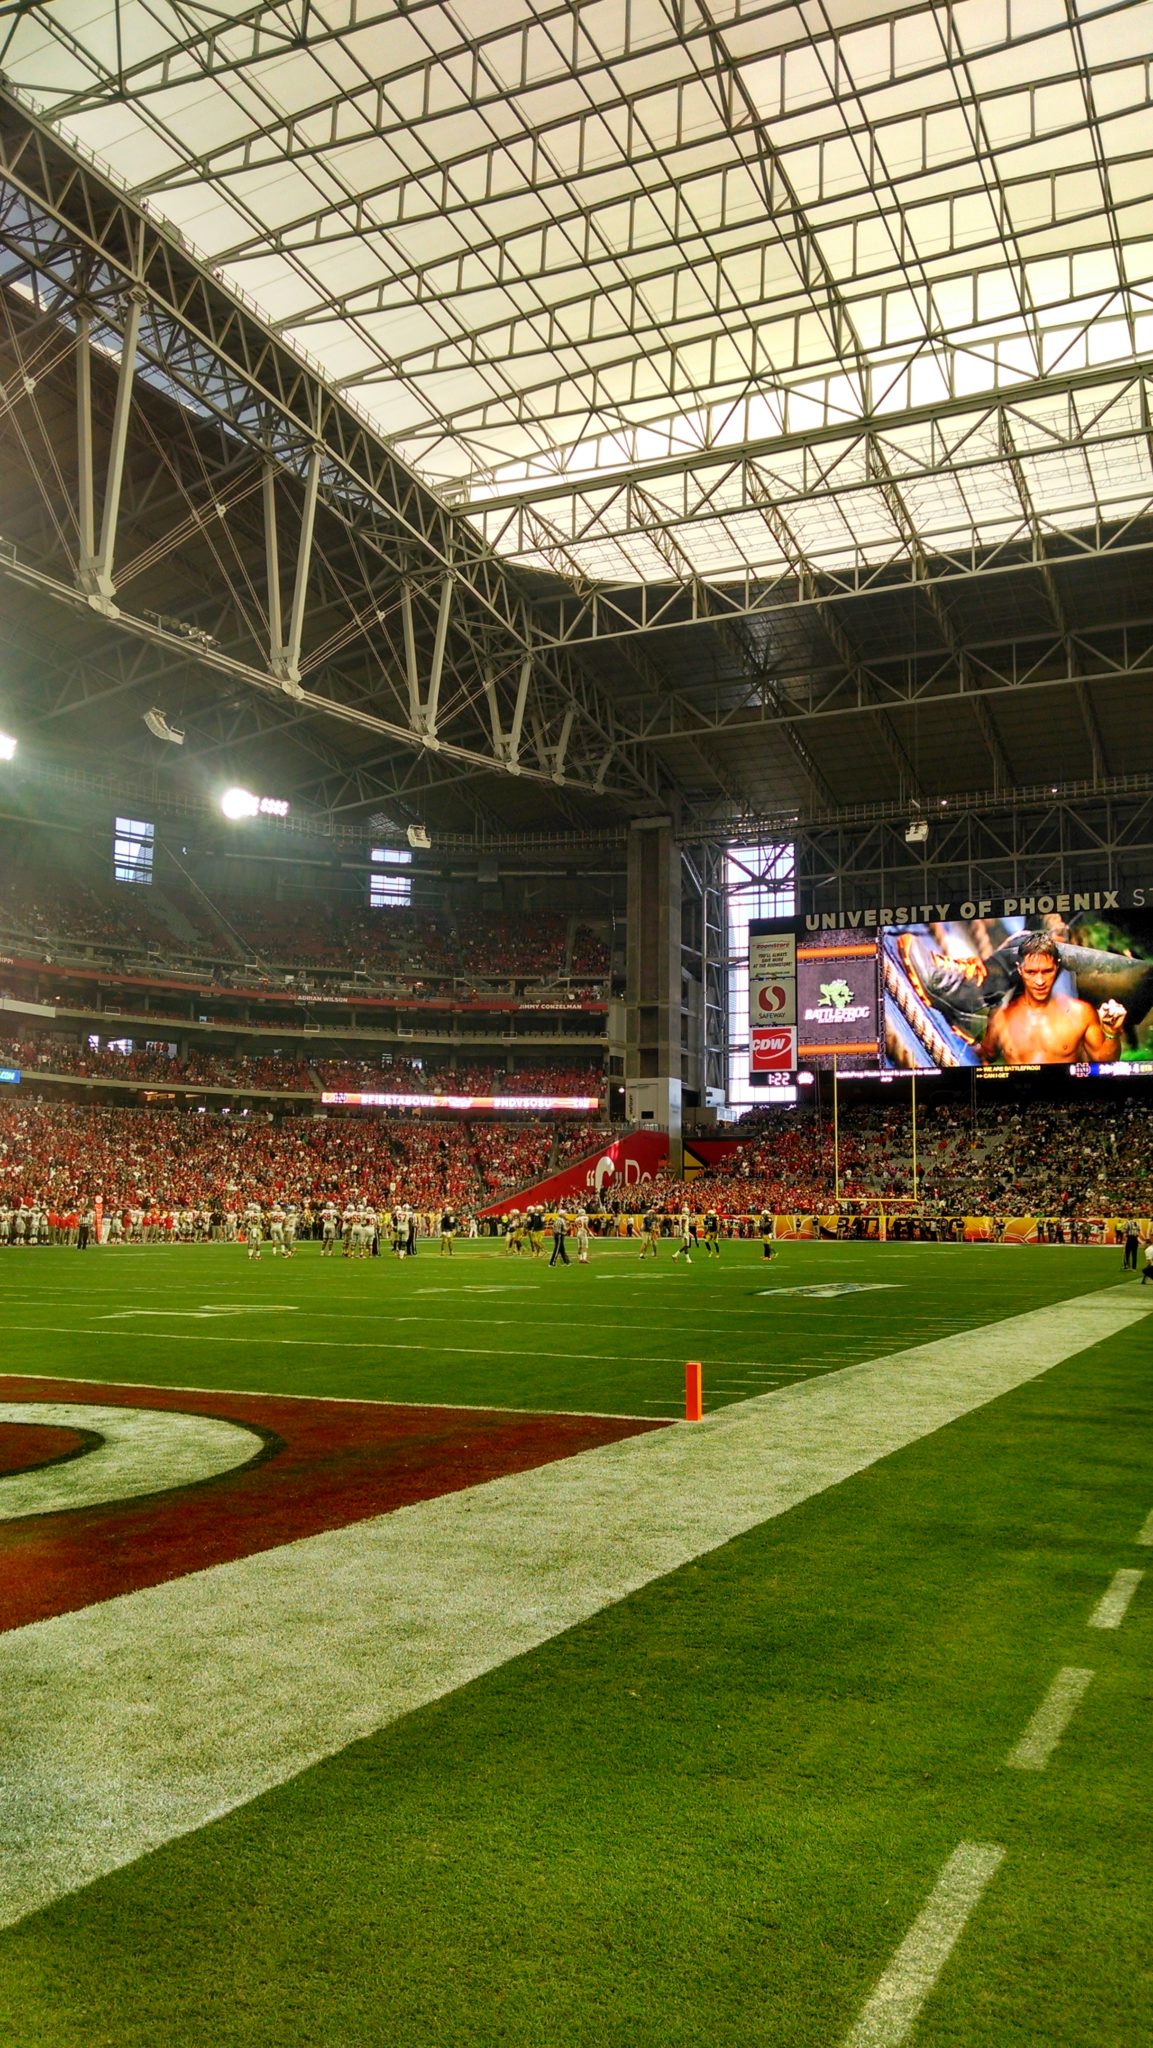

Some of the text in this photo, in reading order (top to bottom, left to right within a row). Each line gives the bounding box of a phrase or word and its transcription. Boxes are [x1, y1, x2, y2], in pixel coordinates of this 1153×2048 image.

[805, 903, 950, 931] UNIVERSITY
[959, 900, 992, 920] OF
[1003, 890, 1120, 916] PHOENIX
[804, 1005, 871, 1020] BATTLEFROG
[752, 1037, 786, 1051] CDW
[768, 1072, 790, 1086] 1:22
